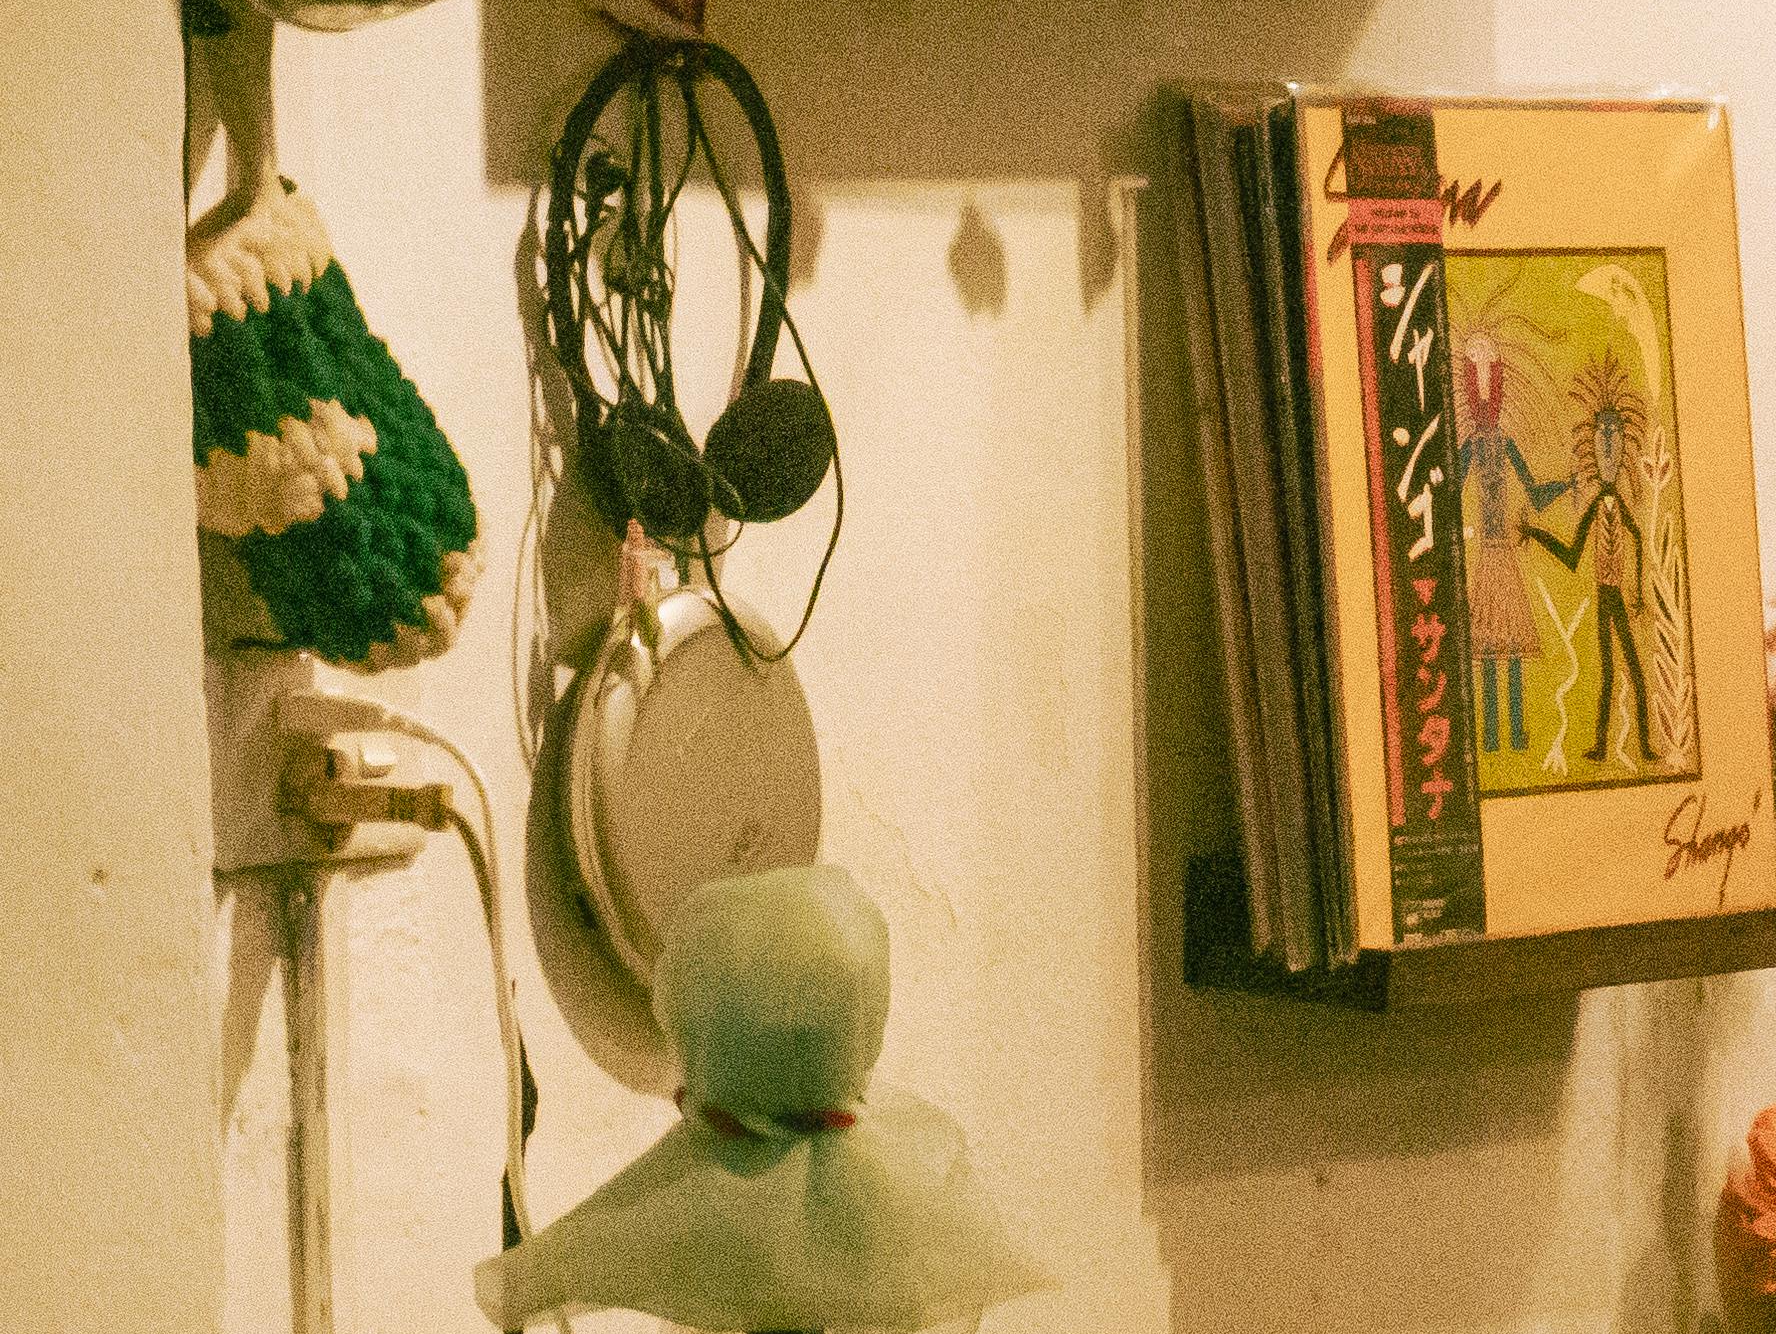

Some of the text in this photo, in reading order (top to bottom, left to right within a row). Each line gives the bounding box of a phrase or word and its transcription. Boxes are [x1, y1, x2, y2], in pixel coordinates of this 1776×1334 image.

[1380, 264, 1444, 561] シャンゴ
[1410, 612, 1455, 823] サンタナ
